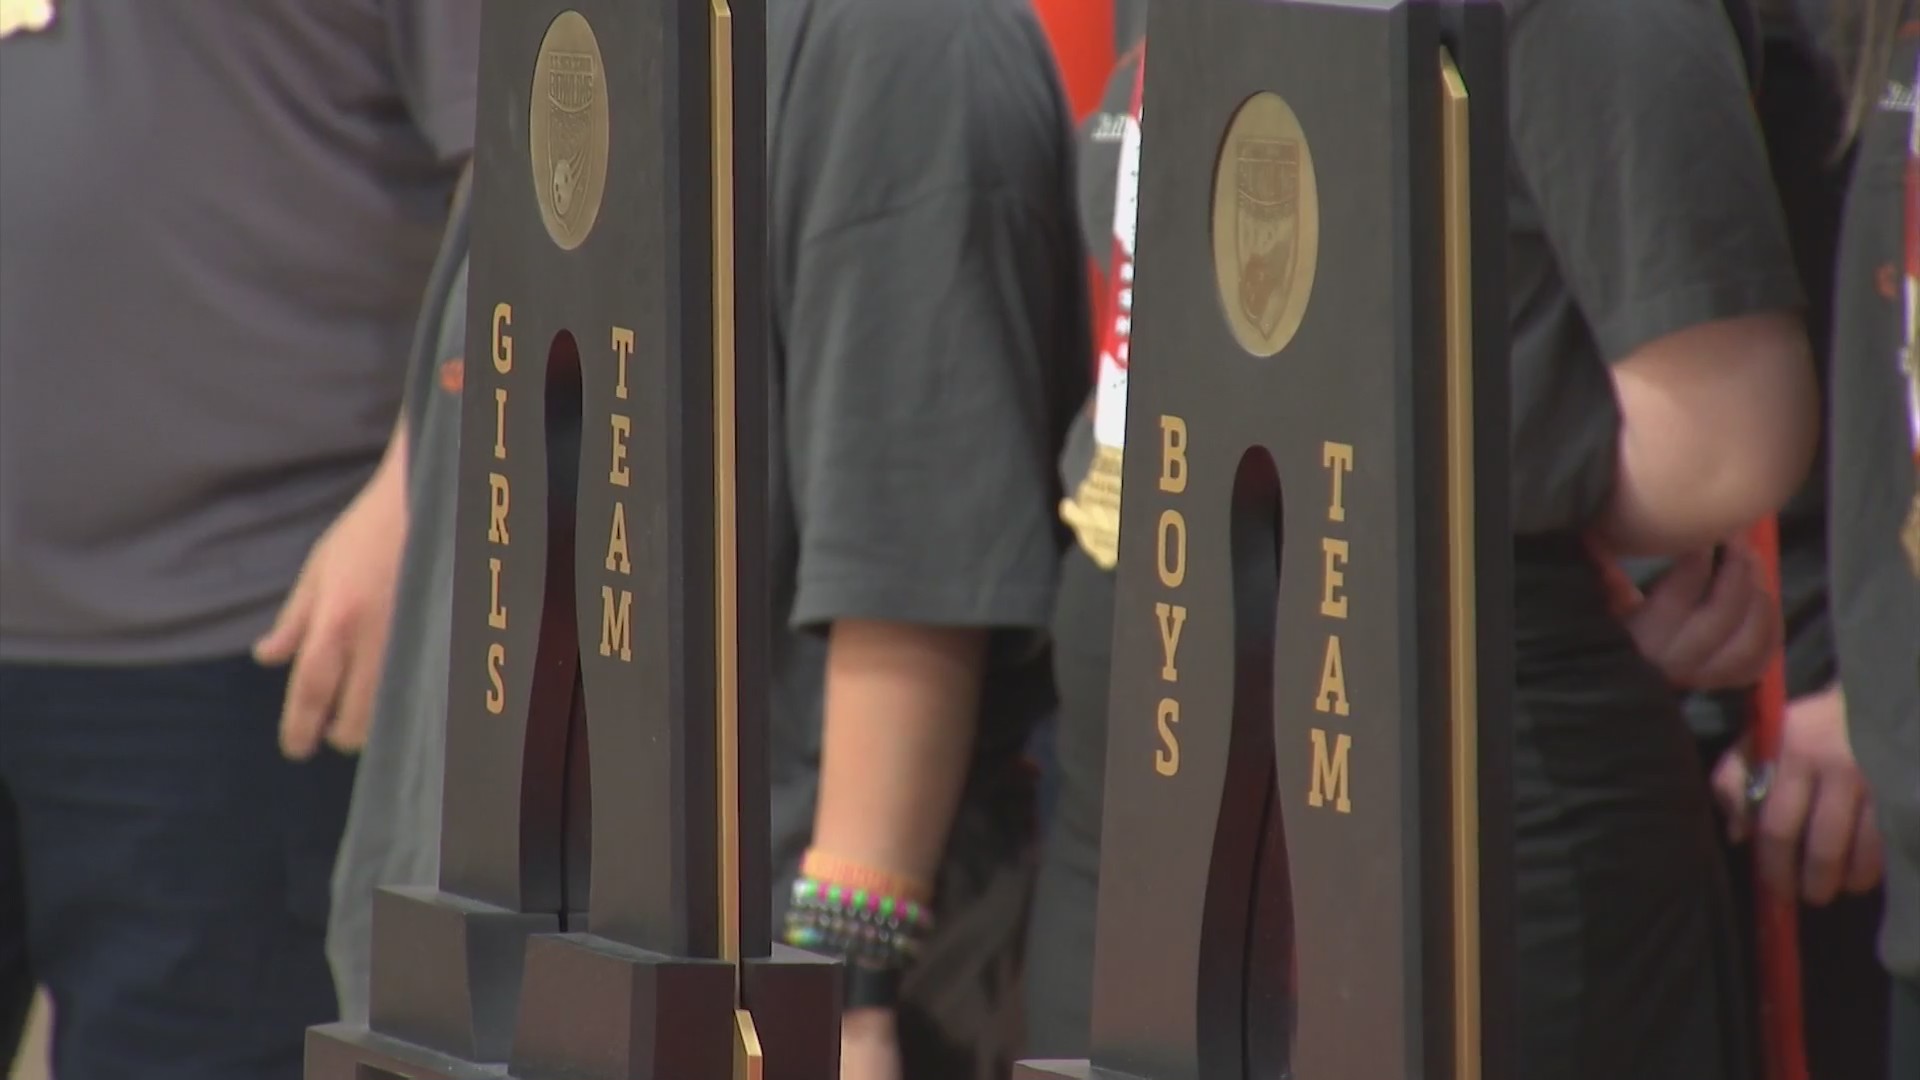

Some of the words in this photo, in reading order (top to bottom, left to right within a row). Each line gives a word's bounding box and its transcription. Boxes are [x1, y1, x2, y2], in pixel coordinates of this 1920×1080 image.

[486, 302, 513, 714] GIRLS
[600, 326, 634, 662] TEAM
[1155, 415, 1187, 776] BOYS
[1309, 441, 1353, 813] TEAM
